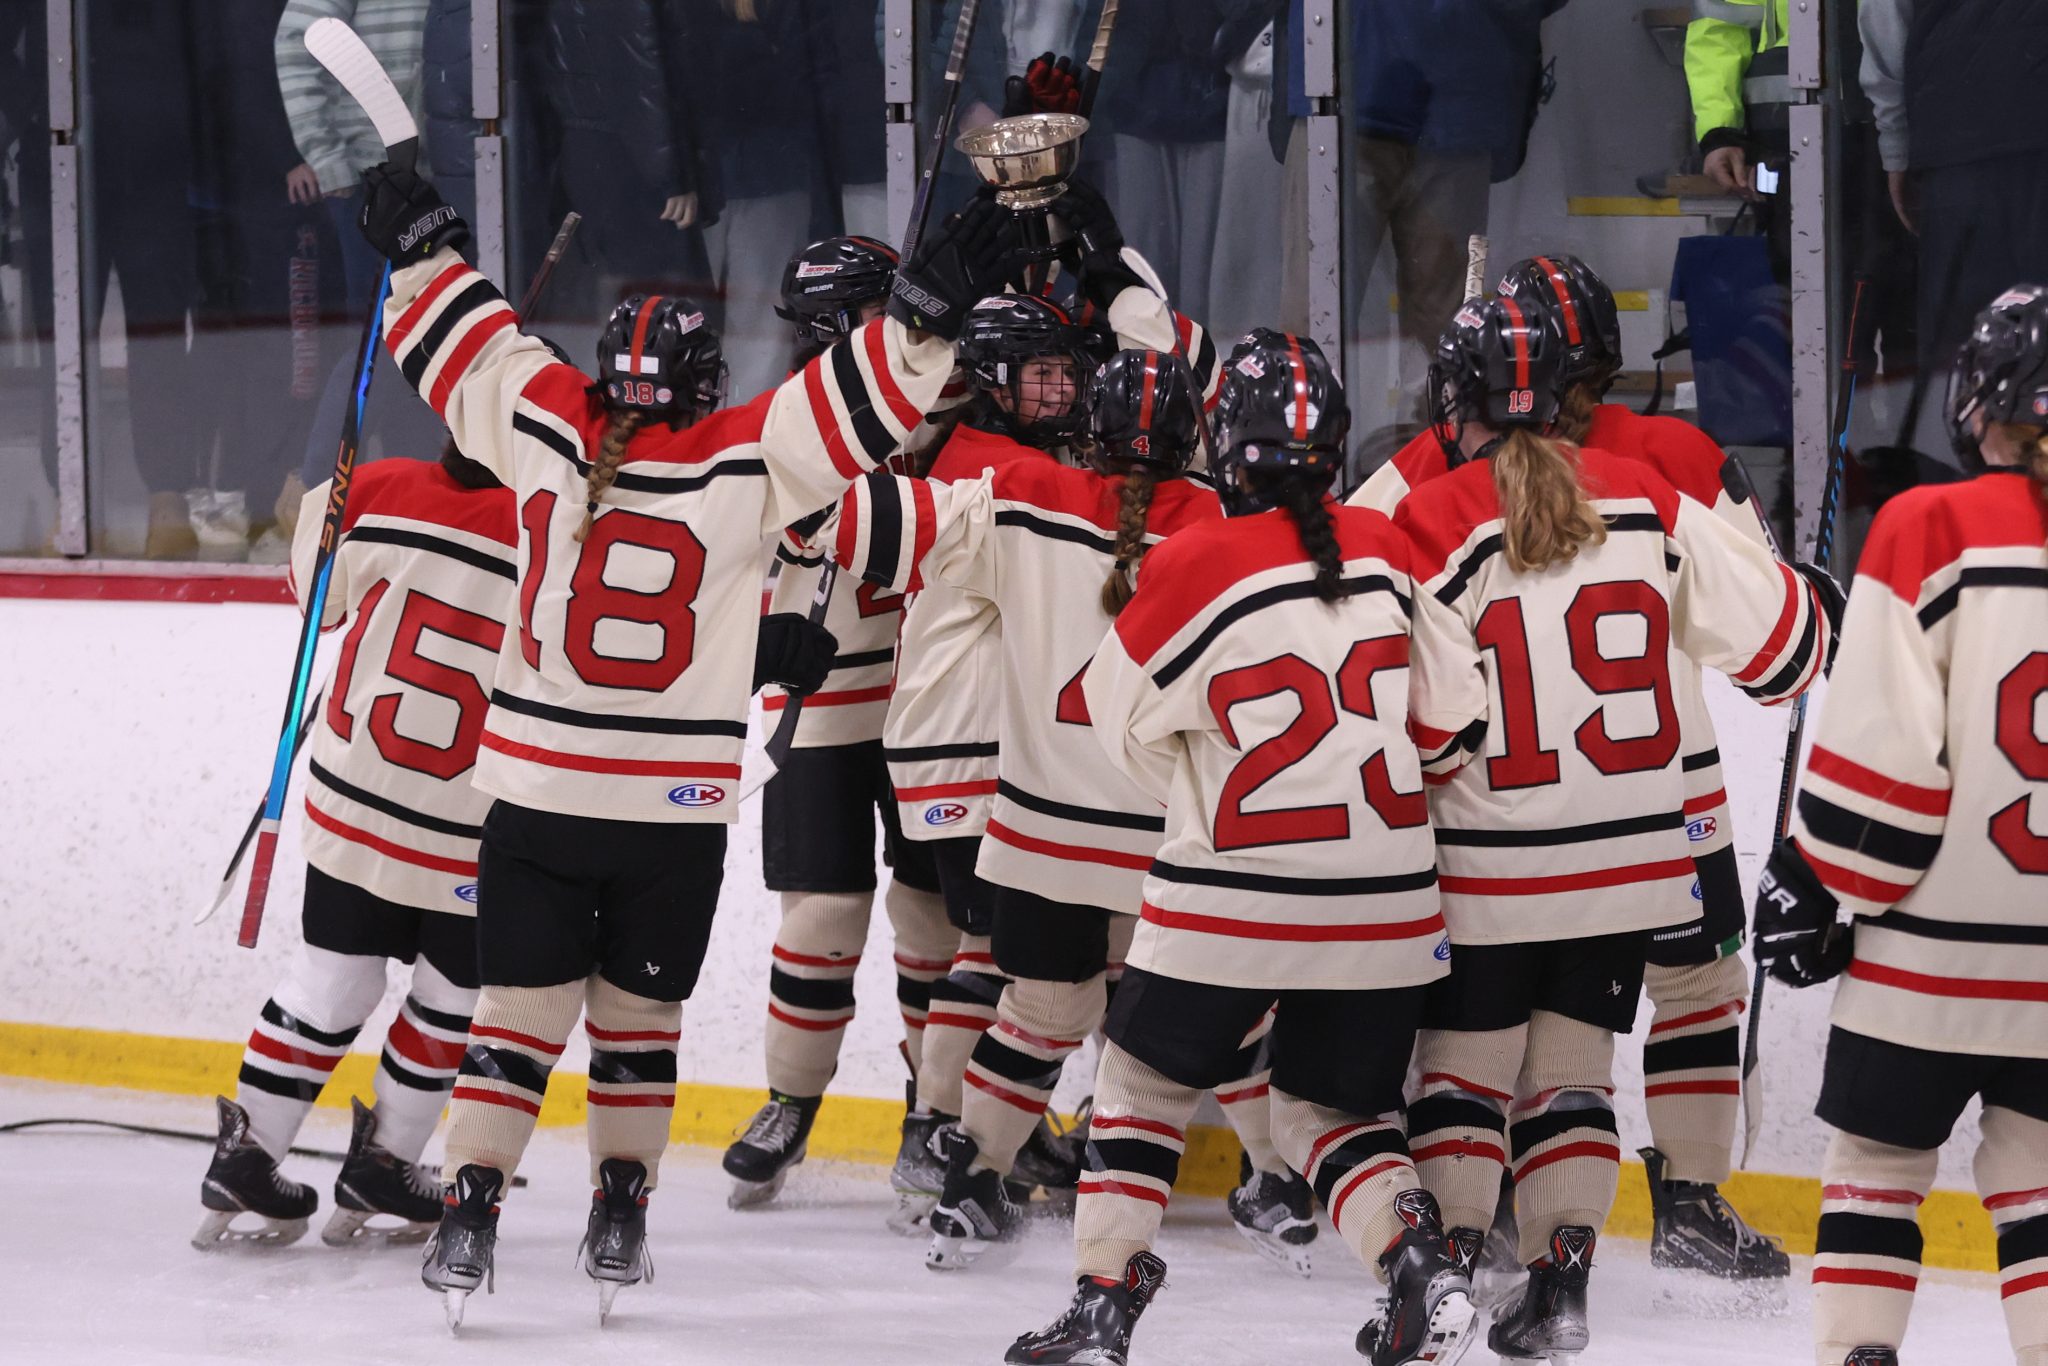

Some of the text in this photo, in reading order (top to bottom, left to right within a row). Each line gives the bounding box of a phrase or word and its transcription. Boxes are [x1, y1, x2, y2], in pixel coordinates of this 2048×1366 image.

[398, 206, 458, 252] UER
[892, 275, 950, 318] BAU
[623, 381, 655, 406] 18
[1508, 390, 1534, 414] 19
[1131, 435, 1150, 456] 4
[320, 440, 354, 553] SYNC
[519, 487, 707, 693] 18
[326, 581, 507, 782] 15
[1475, 579, 1682, 792] 19
[1207, 632, 1430, 853] 23
[1653, 925, 1702, 941] WARRIOR
